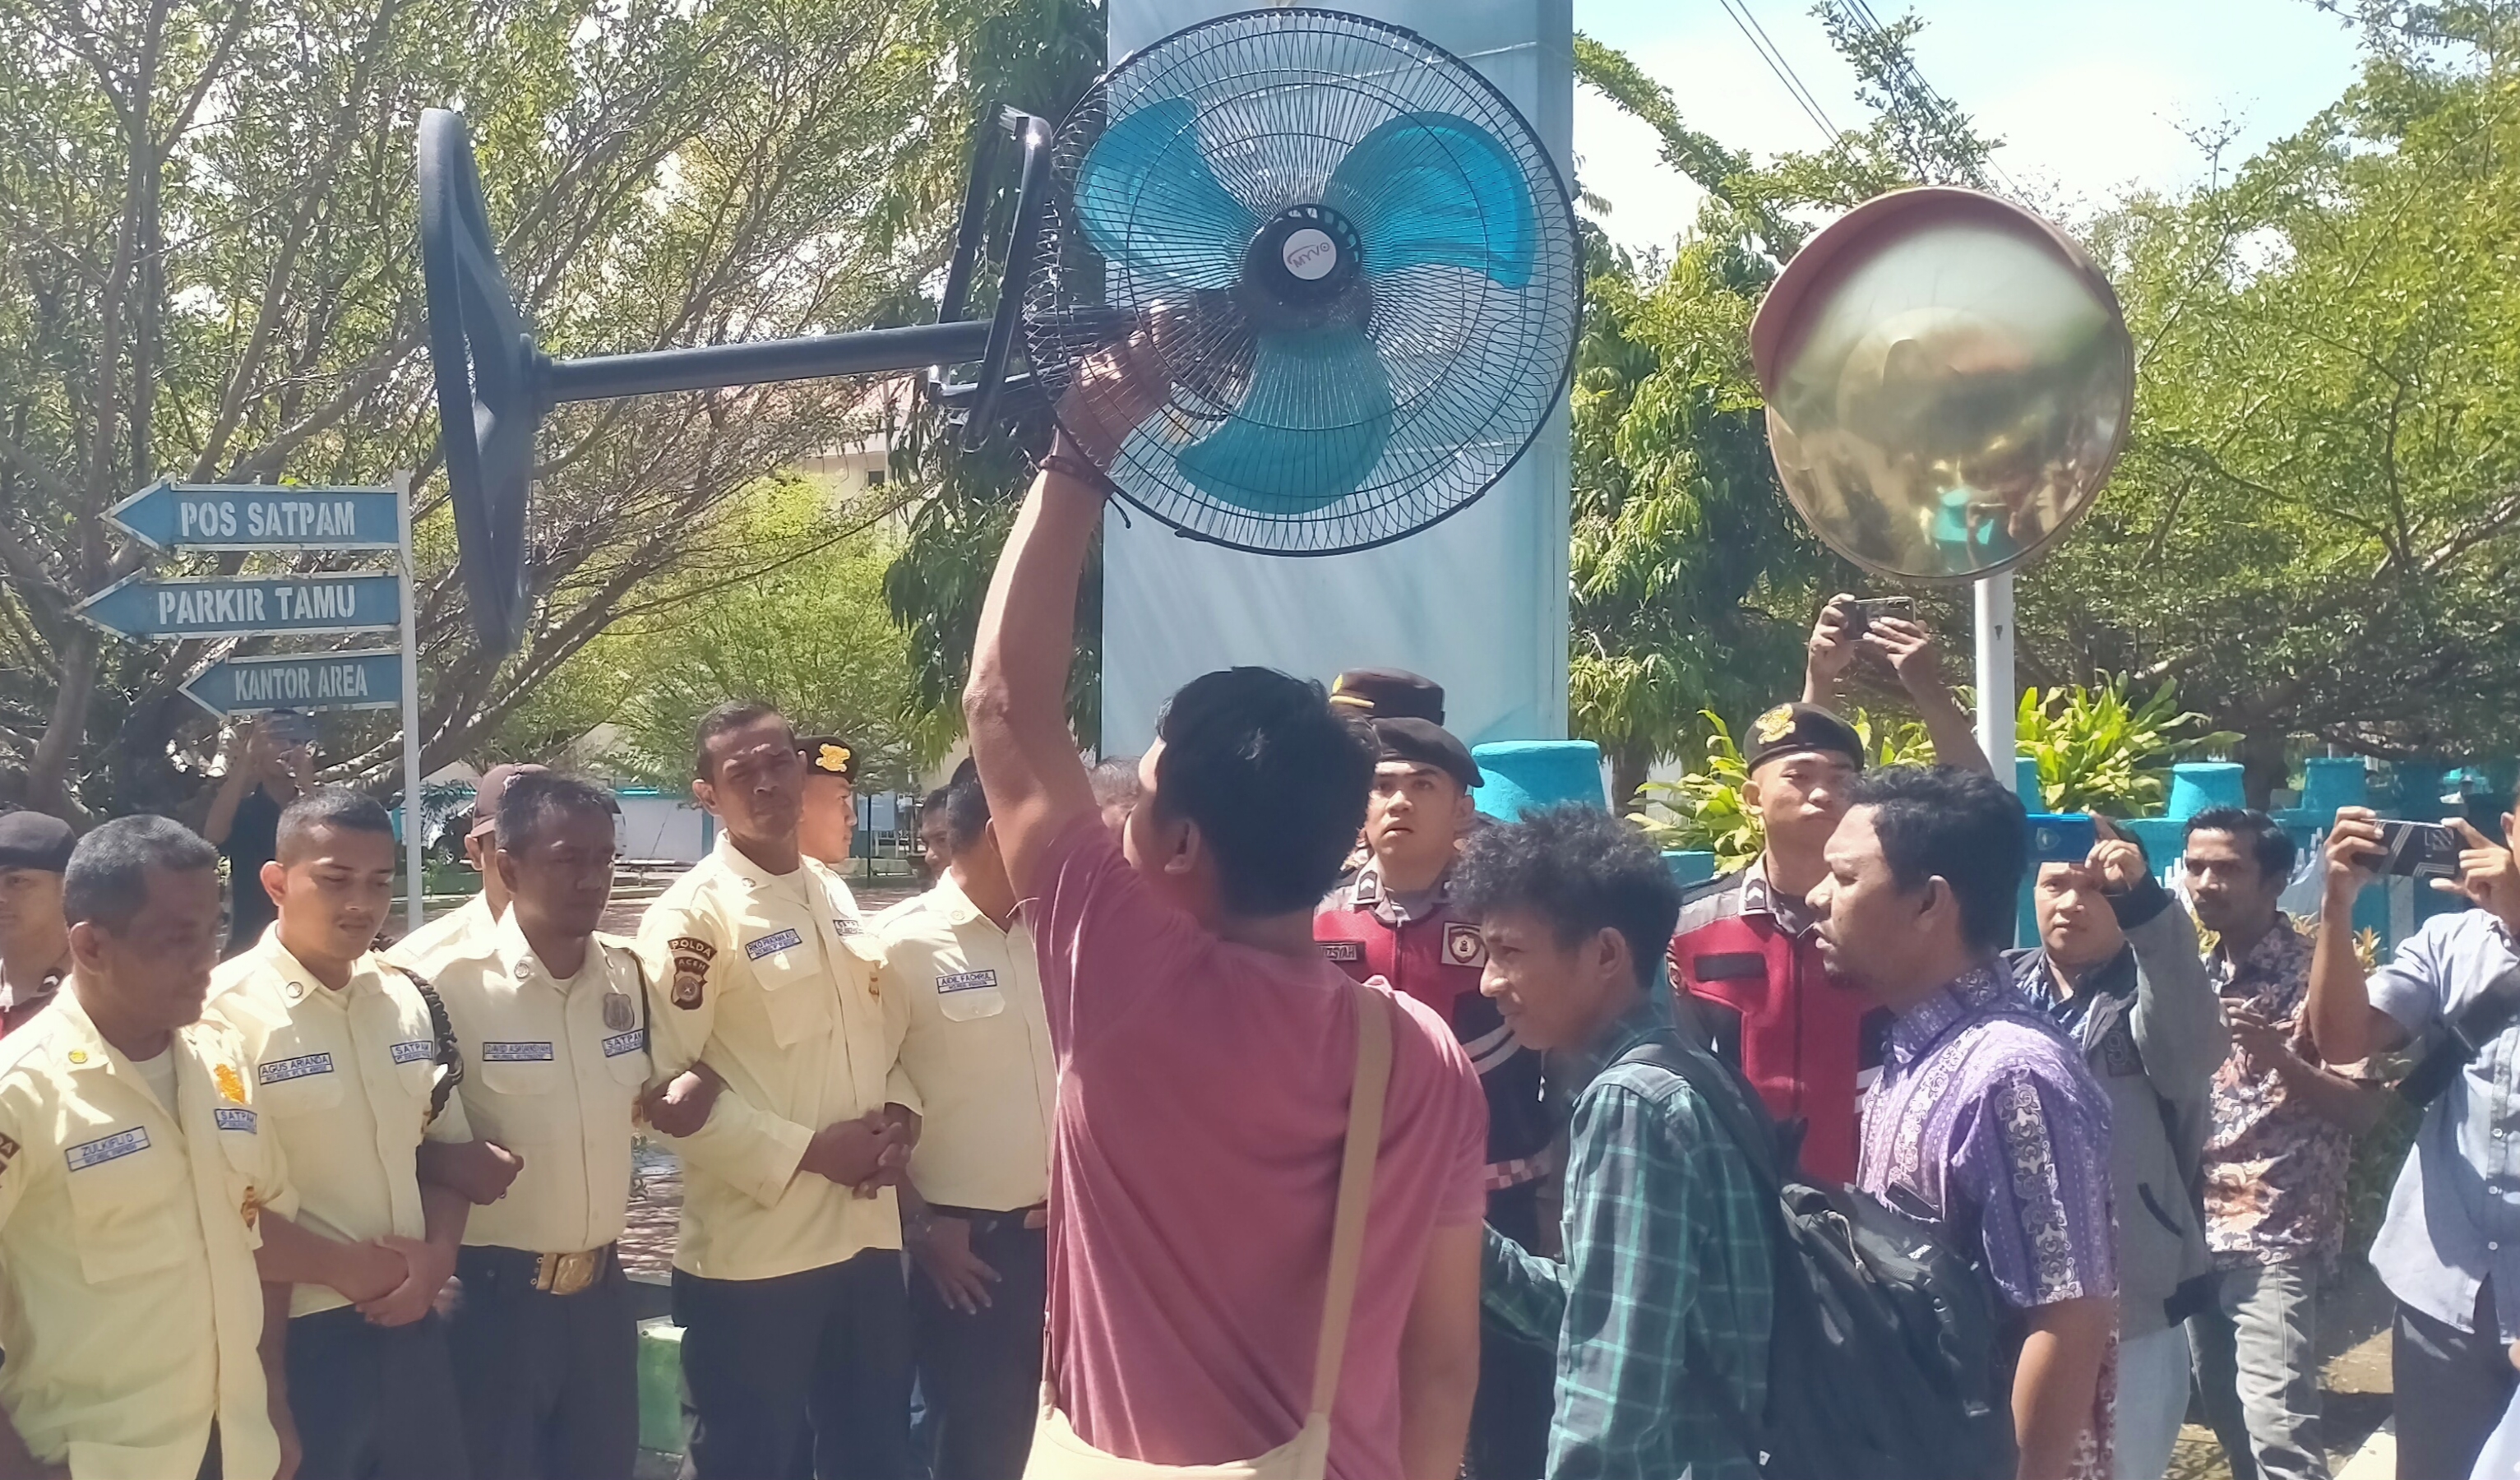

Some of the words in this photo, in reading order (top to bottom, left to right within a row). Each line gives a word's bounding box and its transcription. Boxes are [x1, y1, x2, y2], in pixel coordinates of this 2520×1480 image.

[181, 501, 237, 537] POS
[247, 501, 355, 536] SATPAM
[159, 588, 266, 625] PARKIR
[275, 585, 355, 620] TAMU
[235, 666, 311, 701] KANTOR
[317, 664, 368, 698] AREA
[671, 939, 711, 957] POLDA
[678, 959, 706, 971] ACEH
[395, 1043, 429, 1055] SATPAM
[261, 1061, 288, 1076] AGUS
[290, 1055, 329, 1070] ARIANDA
